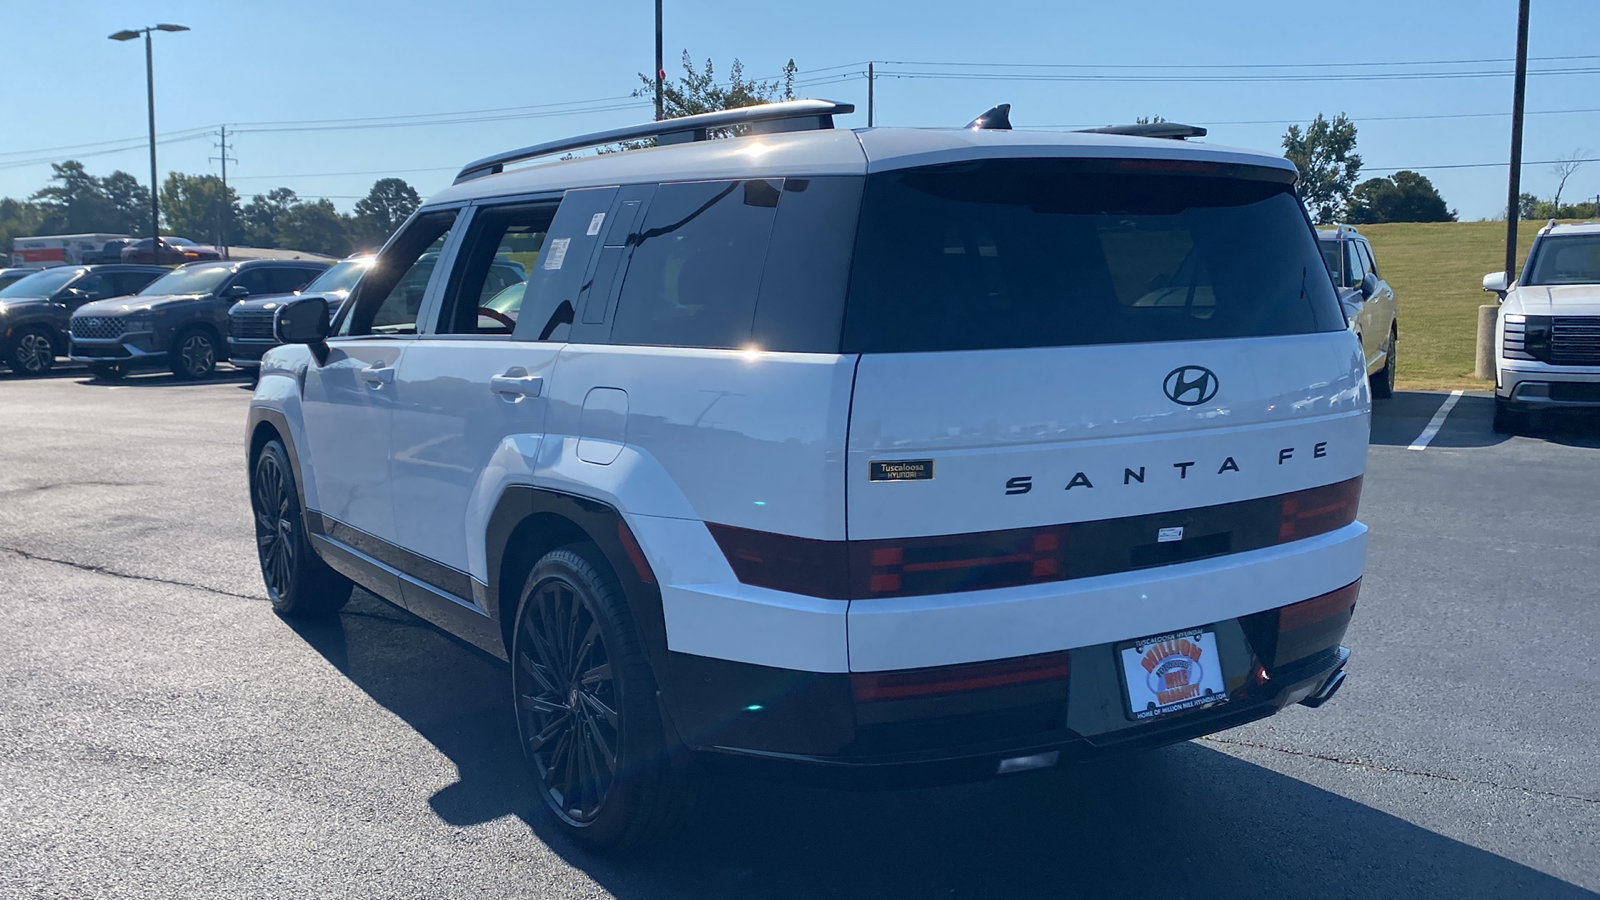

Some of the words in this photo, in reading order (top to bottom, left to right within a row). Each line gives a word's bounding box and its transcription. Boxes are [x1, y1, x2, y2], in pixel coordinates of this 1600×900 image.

[881, 463, 924, 472] Tuscaloosa
[1005, 457, 1240, 495] SANTA
[1278, 441, 1327, 465] FE
[1141, 638, 1203, 674] MILLION
[1137, 711, 1153, 719] HOME
[1153, 708, 1161, 716] OF
